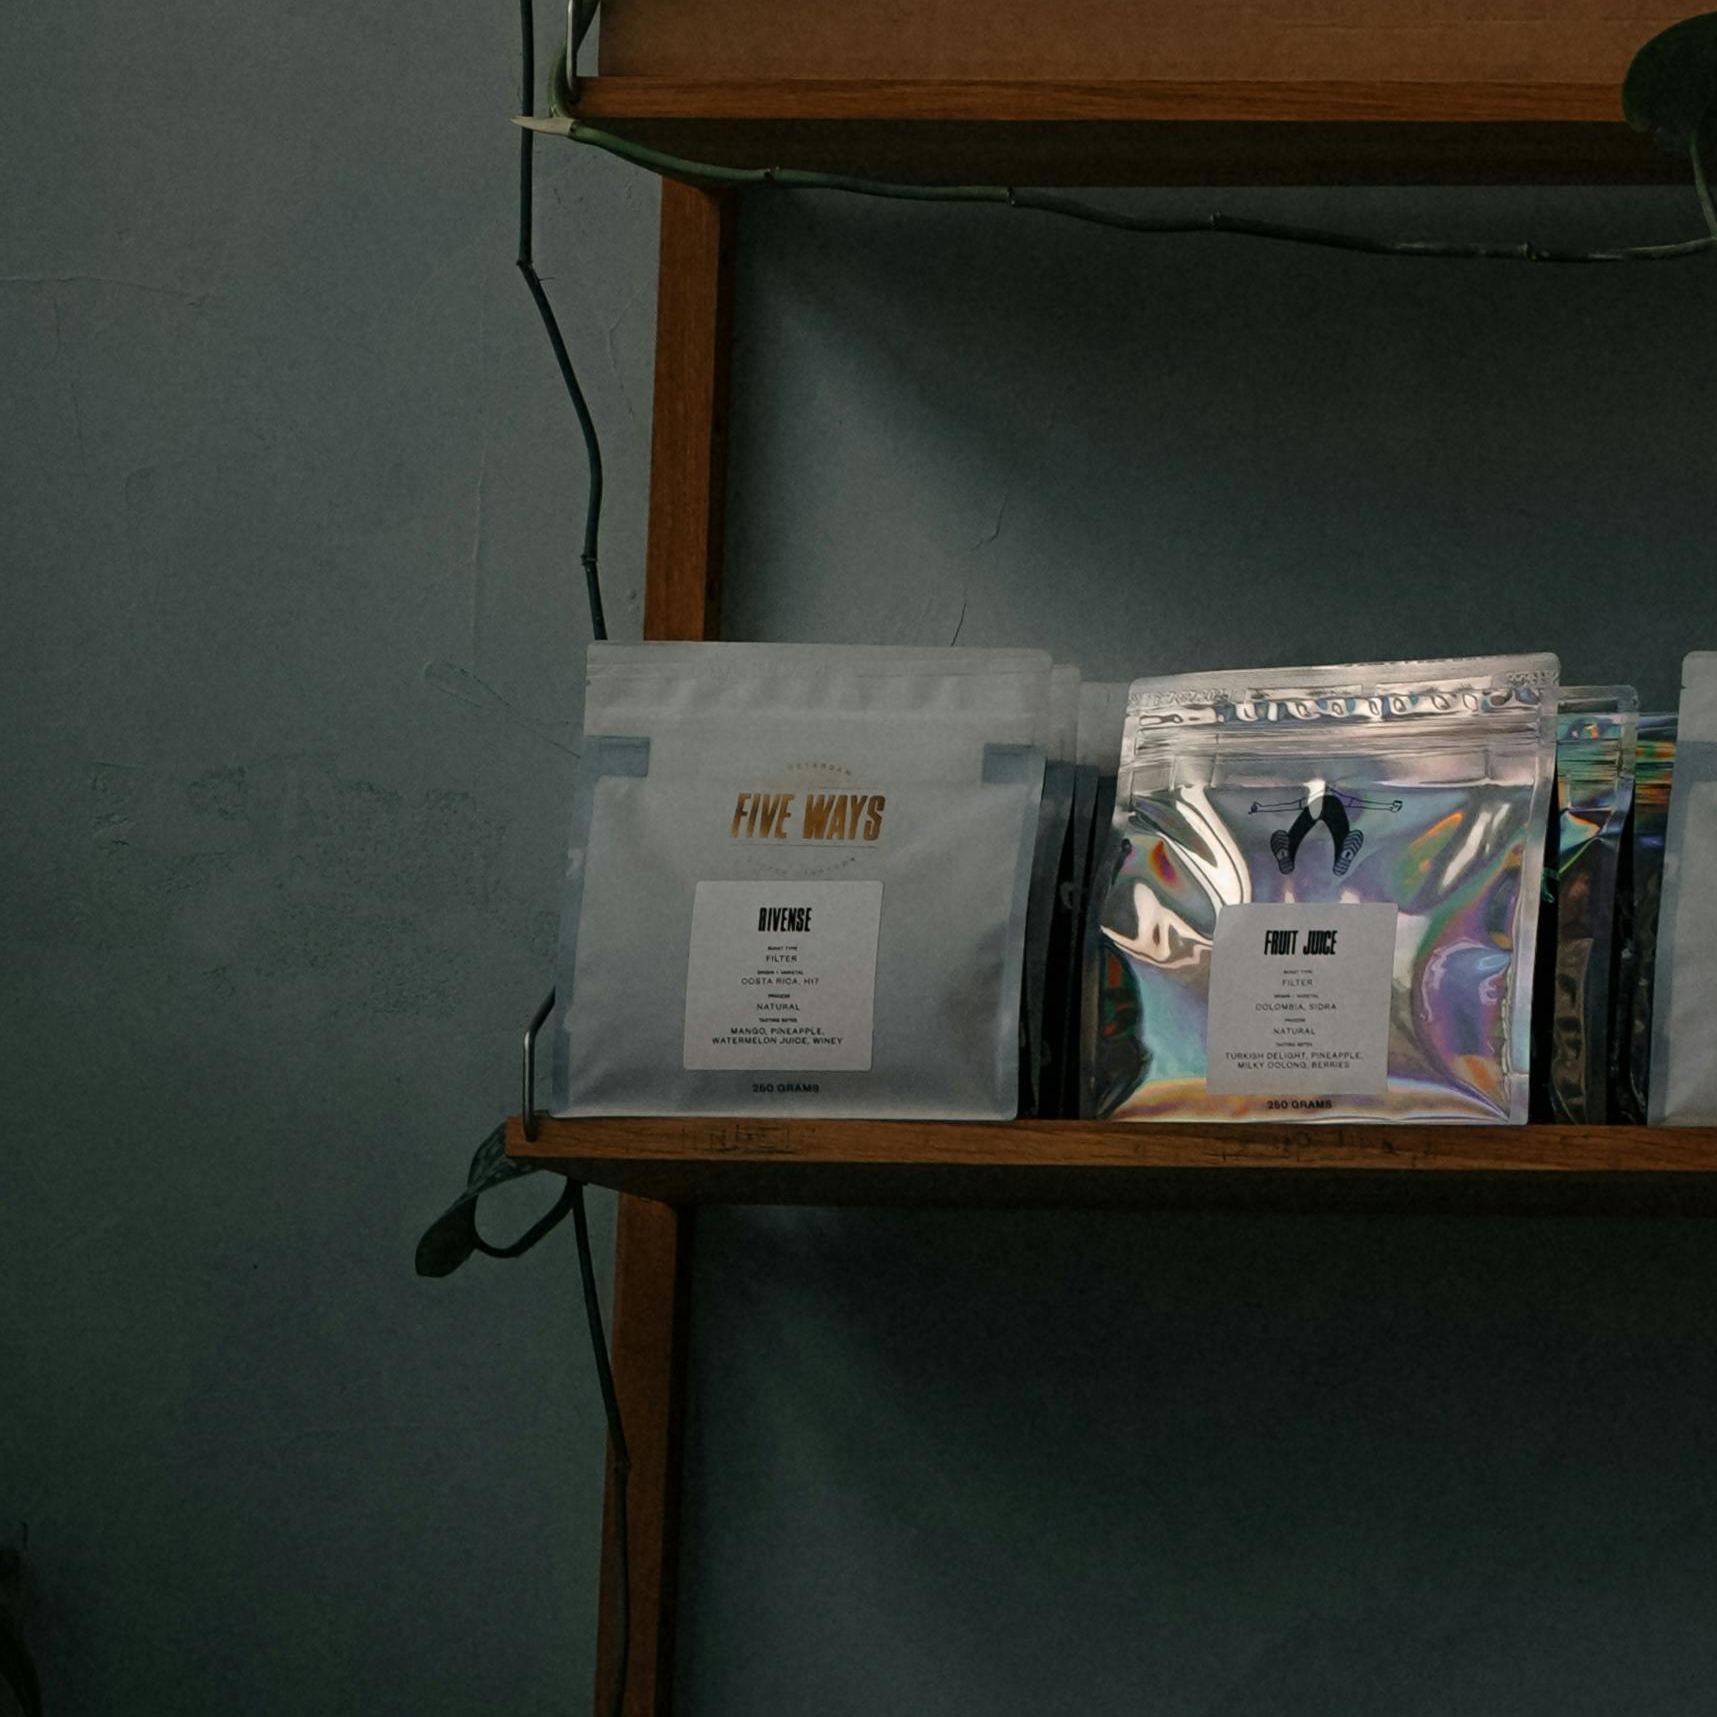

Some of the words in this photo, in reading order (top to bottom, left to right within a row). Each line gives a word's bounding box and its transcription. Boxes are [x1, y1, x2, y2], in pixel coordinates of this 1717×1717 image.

[730, 792, 795, 839] FIVE
[802, 793, 886, 841] WAYS
[1264, 930, 1299, 955] FRUIT
[1303, 930, 1337, 955] JUICE
[741, 977, 772, 985] COSTA
[776, 977, 801, 986] RICA,
[756, 1003, 800, 1011] NATURAL
[1255, 1003, 1307, 1011] COLOMBIA,
[780, 1037, 809, 1045] JUICE,
[1225, 1052, 1264, 1060] TURKISH
[1267, 1052, 1308, 1060] DELIGHT,
[1311, 1052, 1364, 1060] PINEAPPLE,
[1238, 1061, 1265, 1069] MILKY
[1312, 1061, 1350, 1069] BERRIES
[752, 1084, 773, 1092] 250
[777, 1084, 819, 1092] GRAMS
[1292, 1100, 1332, 1109] GRAMS
